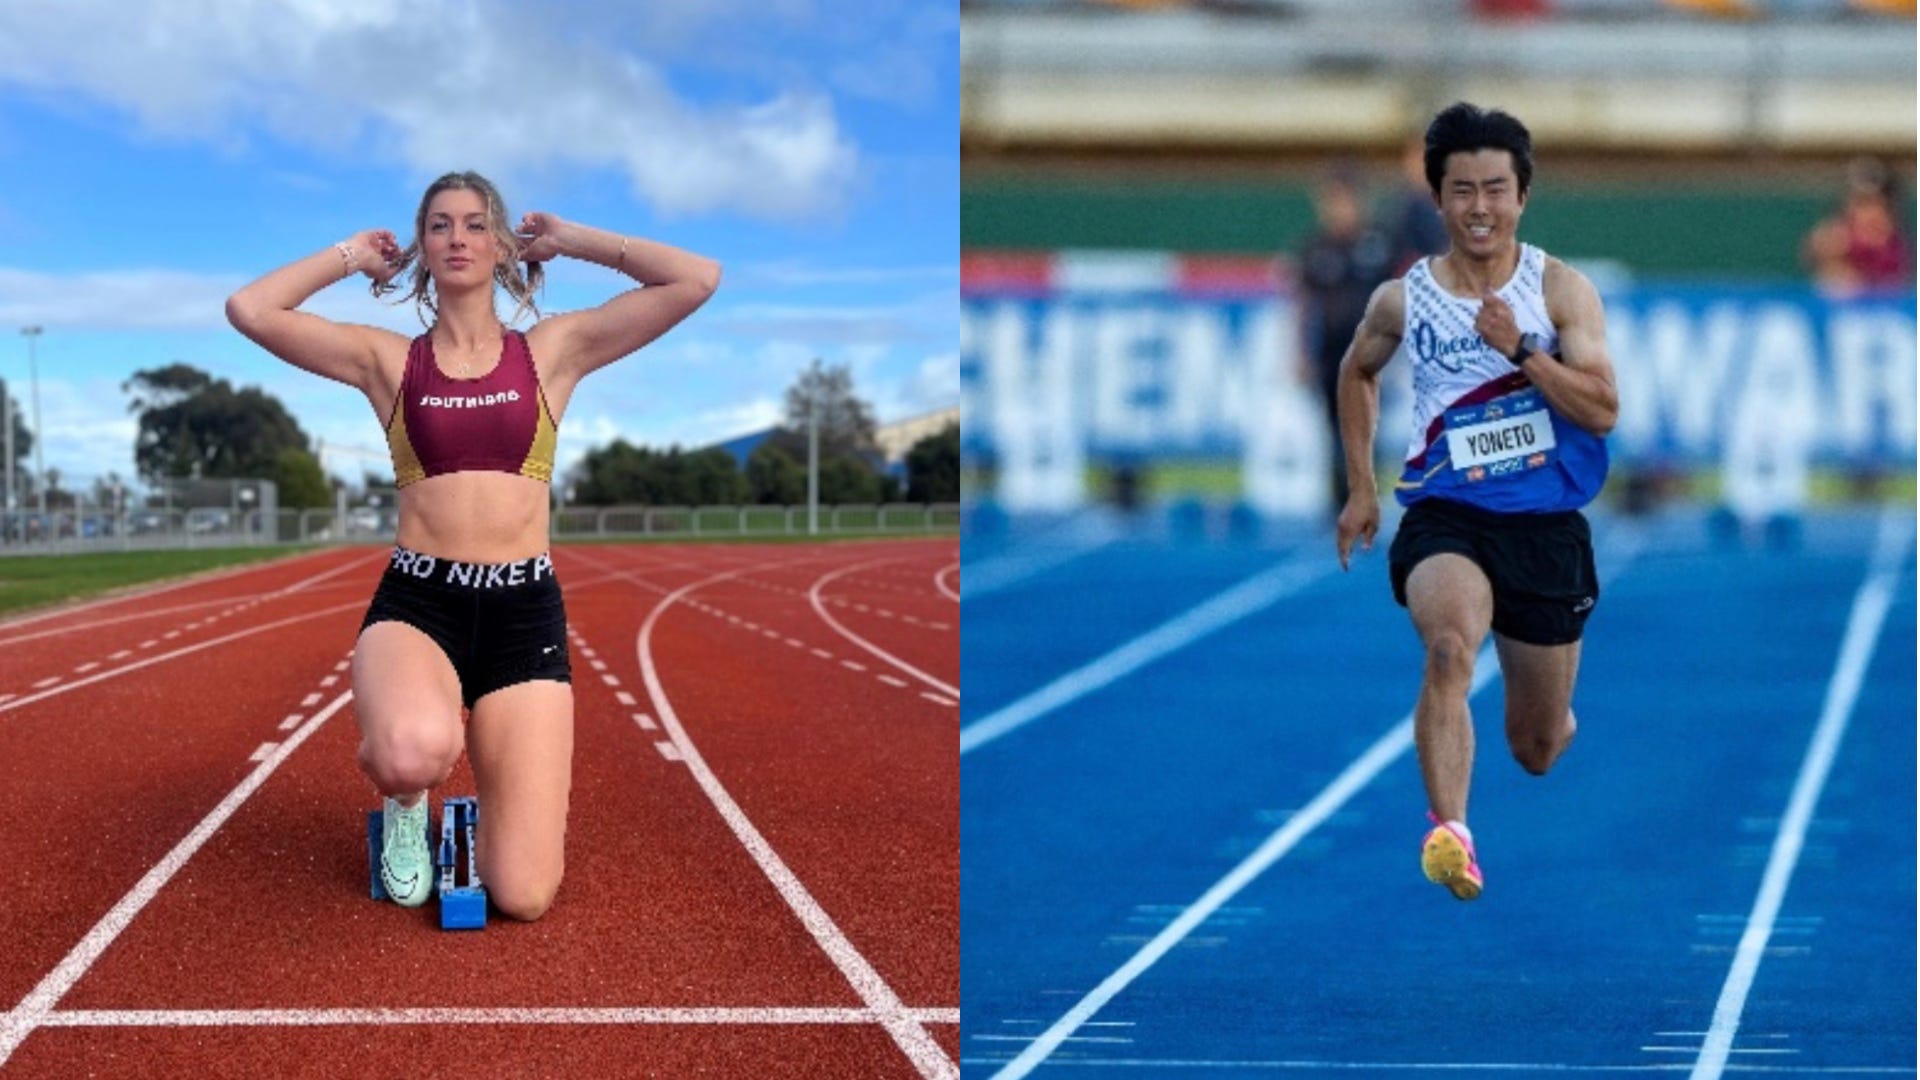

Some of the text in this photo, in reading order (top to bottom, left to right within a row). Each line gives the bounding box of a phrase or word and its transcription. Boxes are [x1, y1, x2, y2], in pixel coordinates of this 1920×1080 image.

[419, 389, 521, 409] SOUTHLAND
[1466, 423, 1536, 458] YONETO
[446, 559, 530, 588] NIKE
